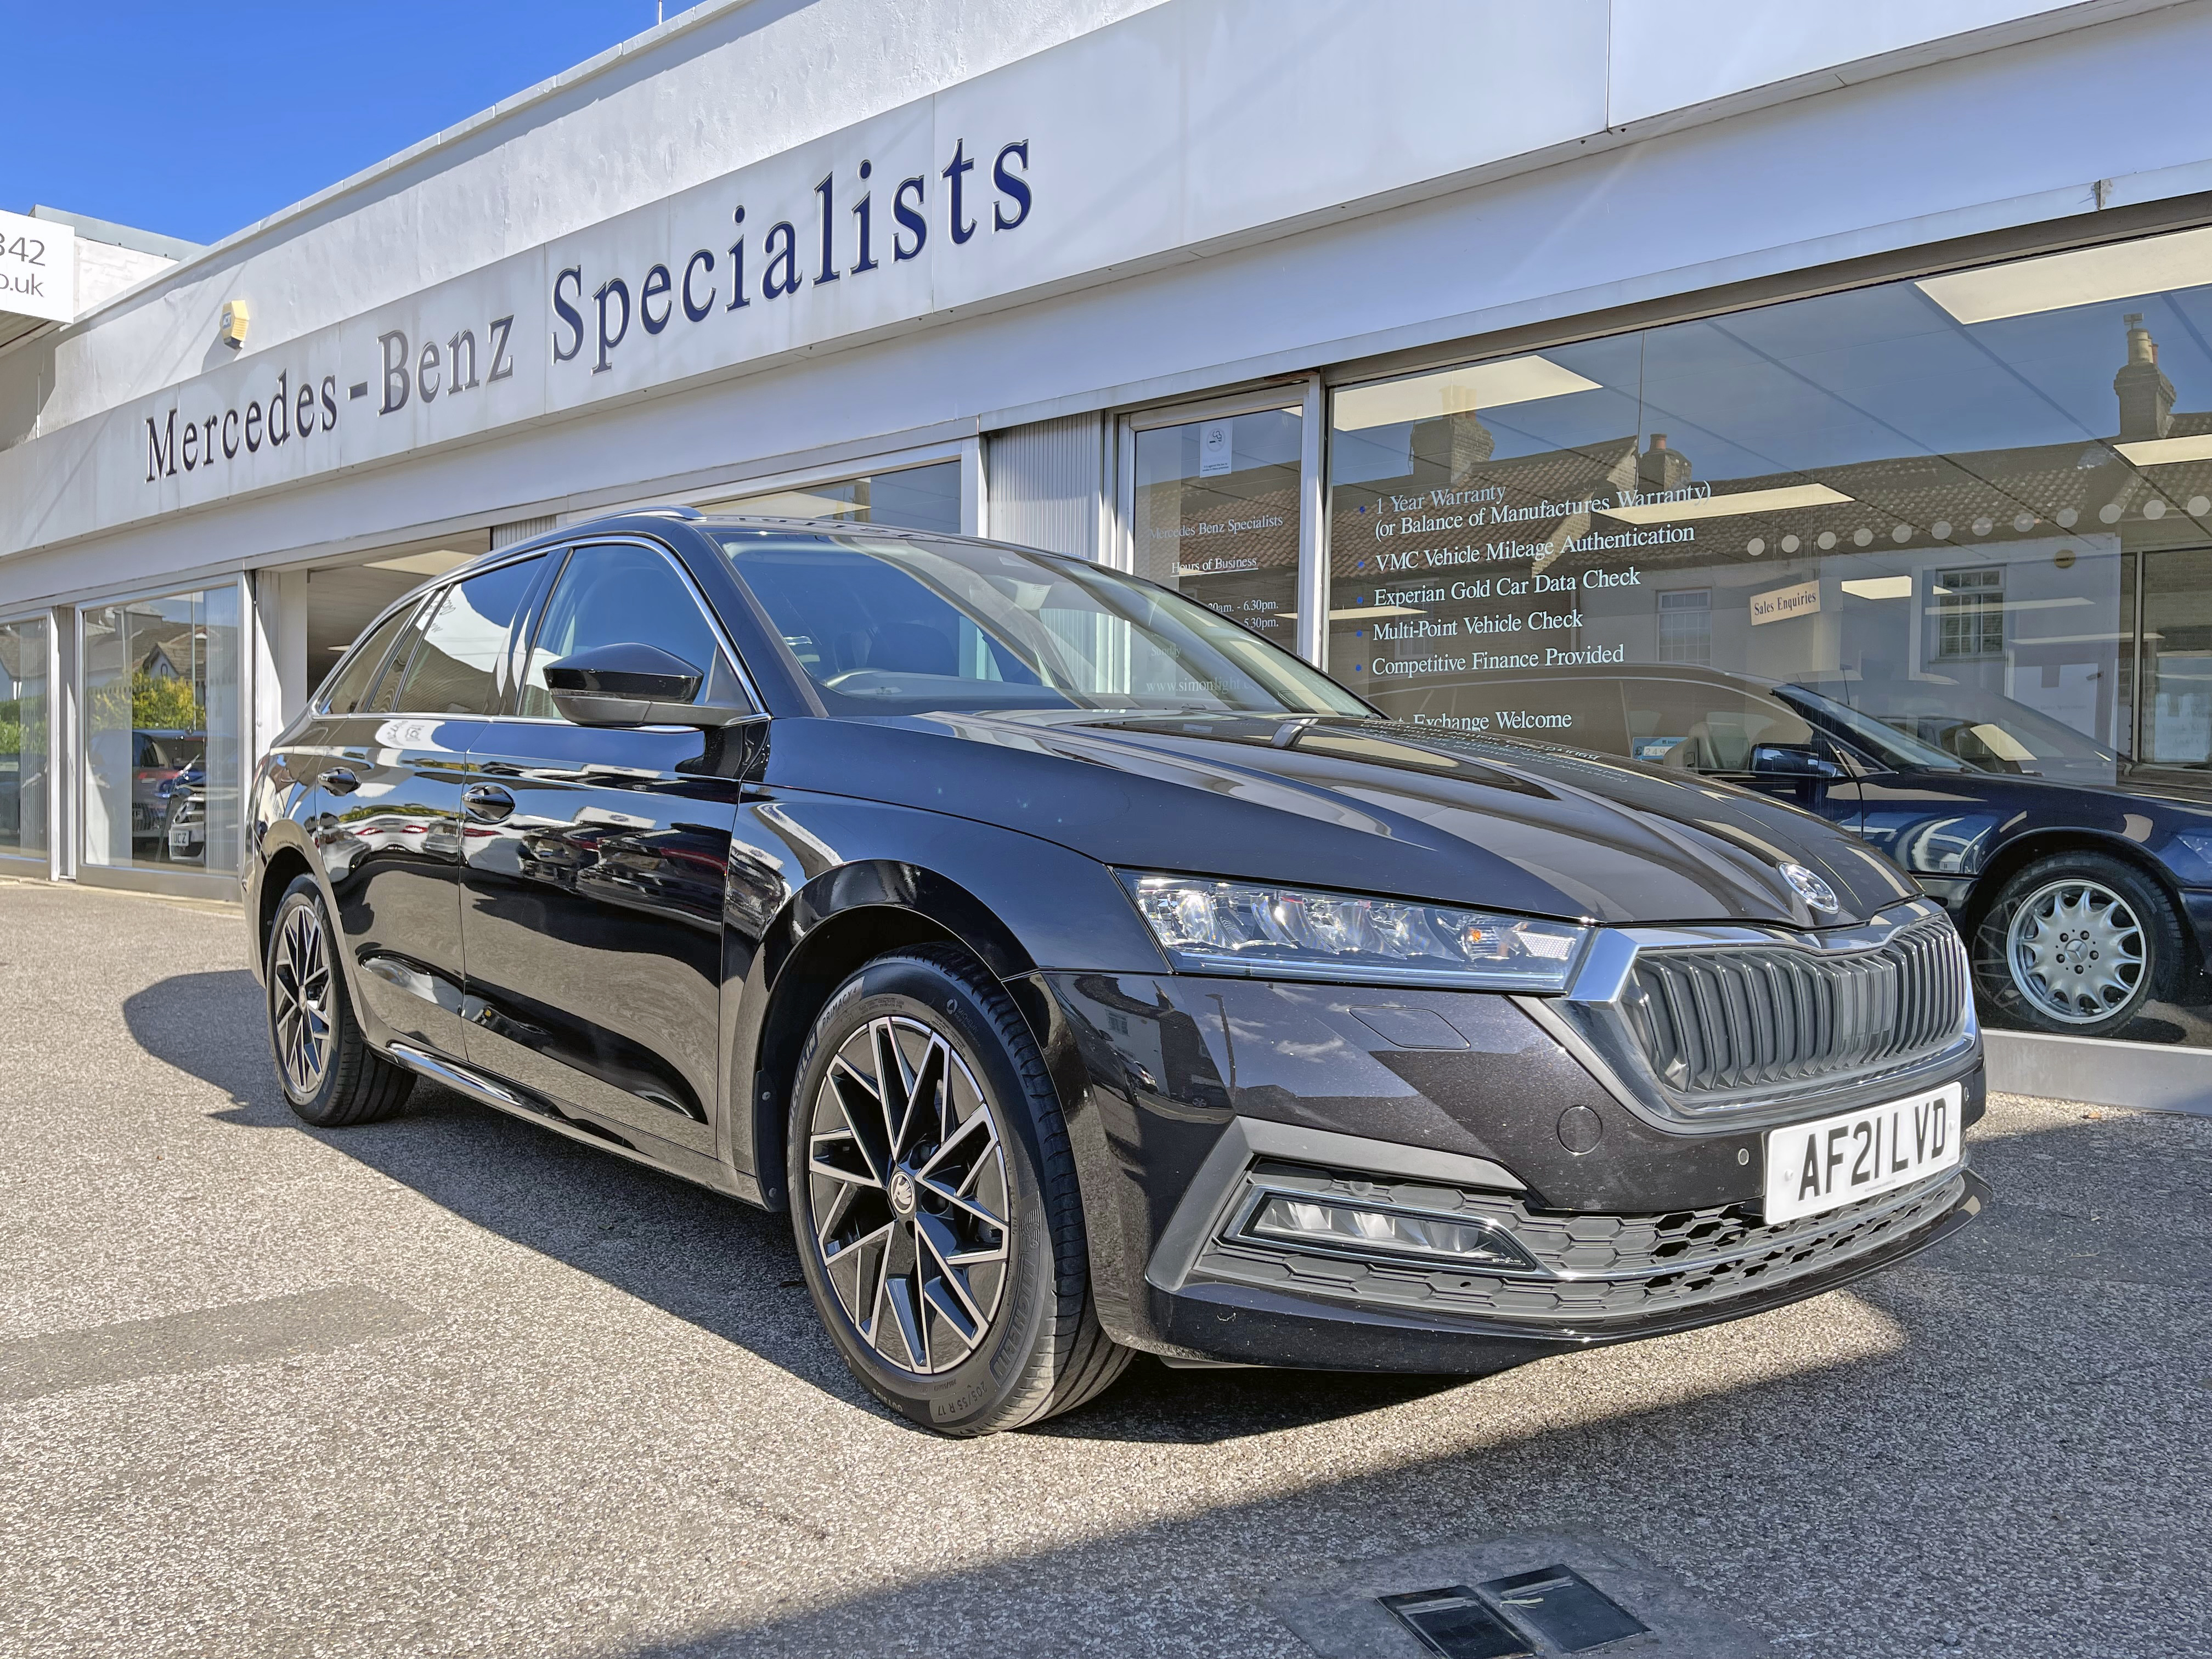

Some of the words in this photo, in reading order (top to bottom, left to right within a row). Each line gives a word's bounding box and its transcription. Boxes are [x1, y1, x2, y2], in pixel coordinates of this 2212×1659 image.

[551, 138, 1032, 376] Specialists
[1375, 520, 1396, 542] (or
[1400, 515, 1463, 534] Balance
[1469, 507, 1486, 526] of
[1491, 497, 1610, 524] Manufactures
[1616, 480, 1711, 508] Warranty)
[1376, 498, 1383, 514] 1
[1390, 494, 1425, 512] Year
[1430, 485, 1506, 507] Warranty
[1150, 526, 1195, 539] Mercedes
[1199, 523, 1224, 535] Benz
[1228, 515, 1283, 534] Specialists
[1376, 551, 1419, 571] VMC
[1424, 545, 1480, 567] Vehicle
[1486, 541, 1554, 561] Mileage
[1559, 524, 1695, 554] Authentication
[1172, 562, 1200, 573] Hours
[1203, 558, 1212, 571] of
[1215, 556, 1257, 569] Business
[1374, 584, 1445, 608] Experian
[1451, 579, 1491, 600] Gold
[1497, 577, 1530, 596] Car
[1534, 574, 1577, 593] Data
[1583, 566, 1641, 589] Check
[1243, 599, 1279, 613] 6.30pm.
[1754, 601, 1774, 616] Sales
[1777, 591, 1816, 611] Enquiries
[1373, 619, 1458, 641] Multi-Point
[1463, 613, 1522, 635] Vehicle
[1528, 609, 1583, 630] Check
[1152, 646, 1181, 658] Sunday
[1372, 653, 1466, 679] Competitive
[1471, 651, 1539, 670] Finance
[1544, 644, 1624, 667] Provided
[1495, 711, 1572, 729] Welcome
[822, 989, 852, 1028] PRIMACY
[788, 1032, 817, 1139] MICHELIN
[872, 1387, 904, 1412] OUTSIDE
[957, 1380, 988, 1412] 205/55
